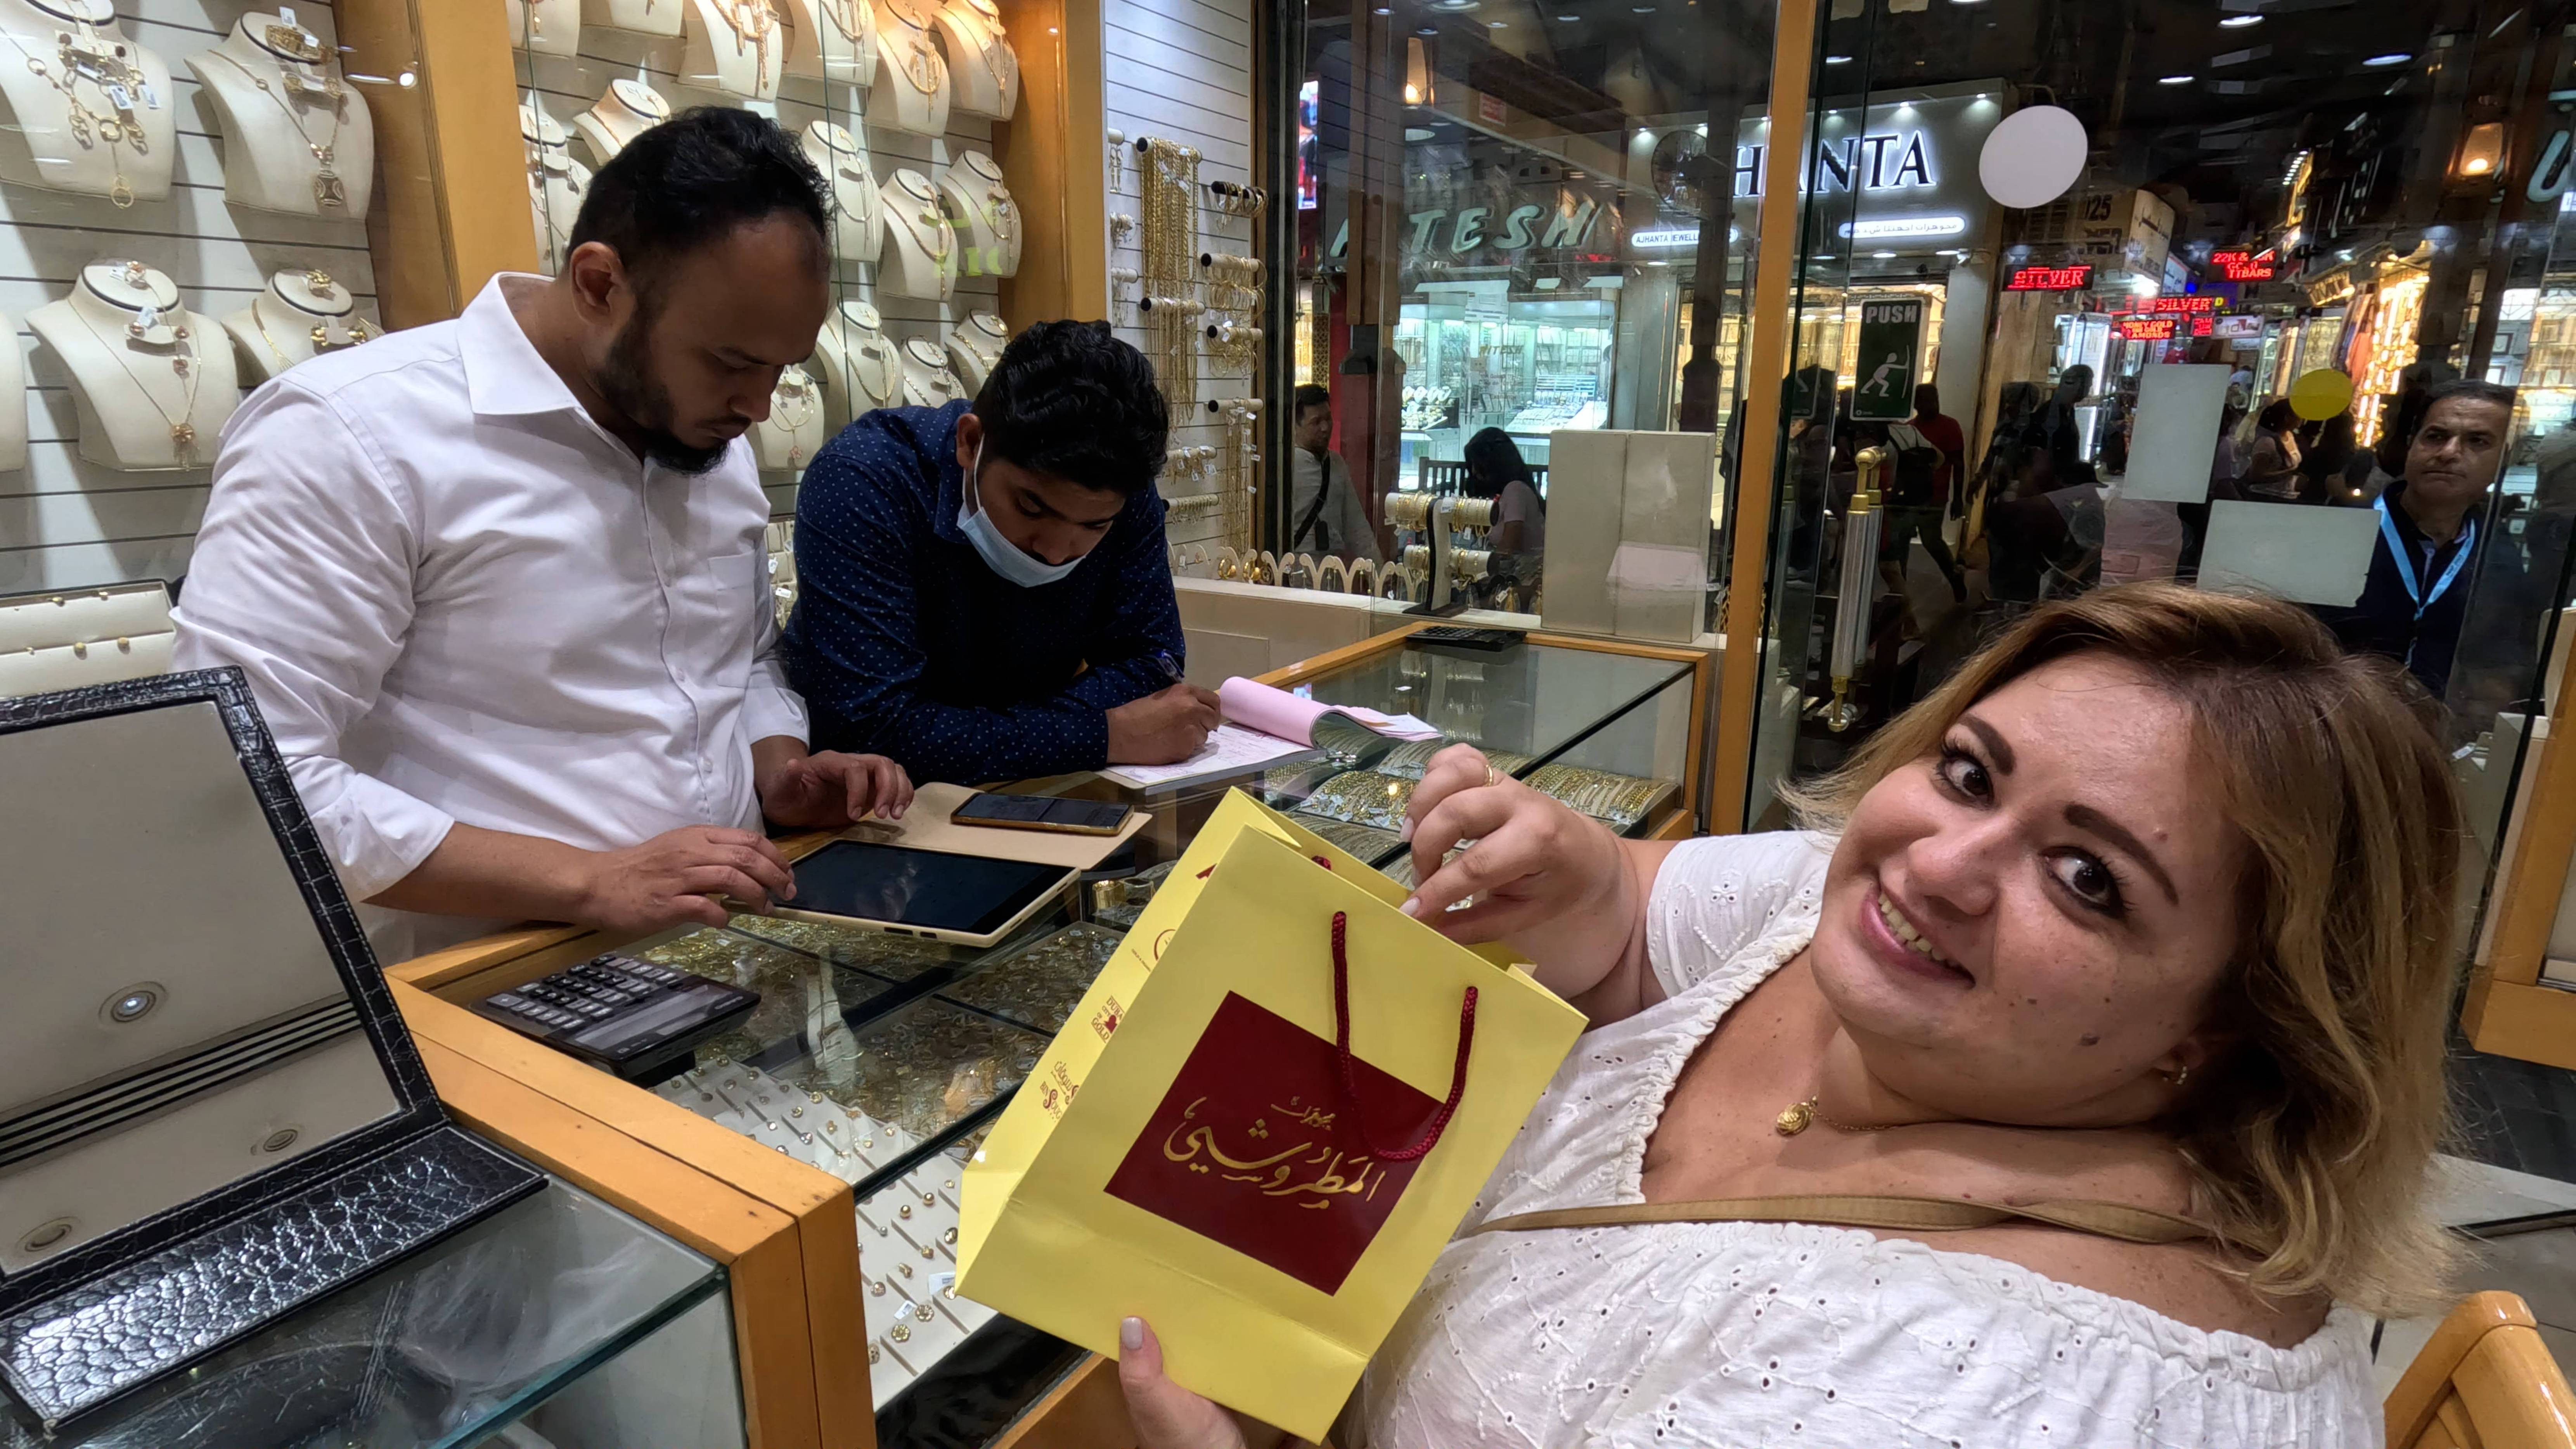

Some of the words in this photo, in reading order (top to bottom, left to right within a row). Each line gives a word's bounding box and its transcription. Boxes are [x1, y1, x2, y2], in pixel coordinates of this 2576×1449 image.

[1733, 130, 1937, 197] HNTA
[1636, 233, 1668, 243] AJHANTA
[2013, 270, 2084, 288] SILVER
[2155, 297, 2211, 312] SILVER
[1865, 305, 1917, 324] PUSH
[1106, 997, 1123, 1021] DUBA
[1092, 1017, 1110, 1040] GOLD
